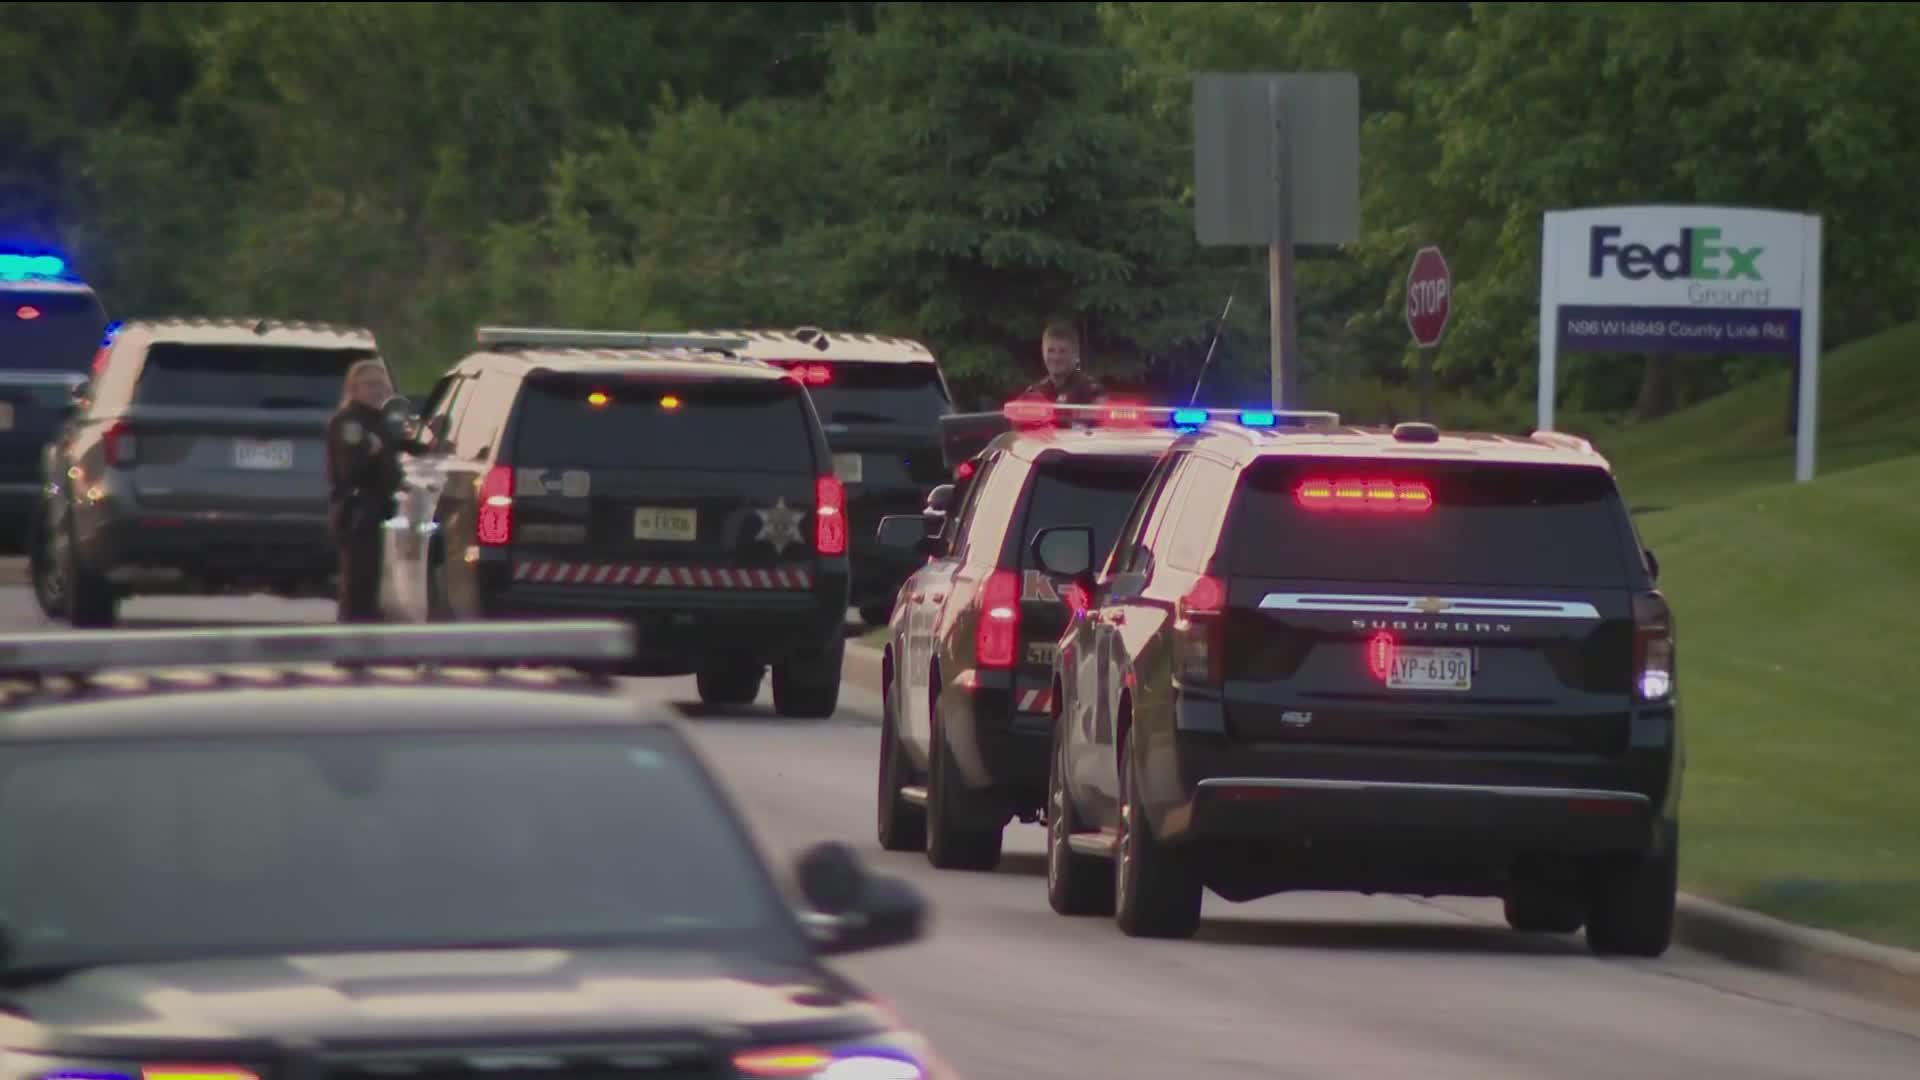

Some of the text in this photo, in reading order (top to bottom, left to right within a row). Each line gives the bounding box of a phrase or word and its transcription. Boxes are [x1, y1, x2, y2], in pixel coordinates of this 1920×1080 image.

[1589, 225, 1765, 280] FedEx
[1411, 279, 1446, 317] STOP
[1688, 282, 1771, 305] Ground
[1669, 321, 1722, 339] County
[1727, 322, 1758, 338] Line
[1352, 619, 1512, 632] SUBURBAN
[1391, 657, 1467, 681] AYP-6190
